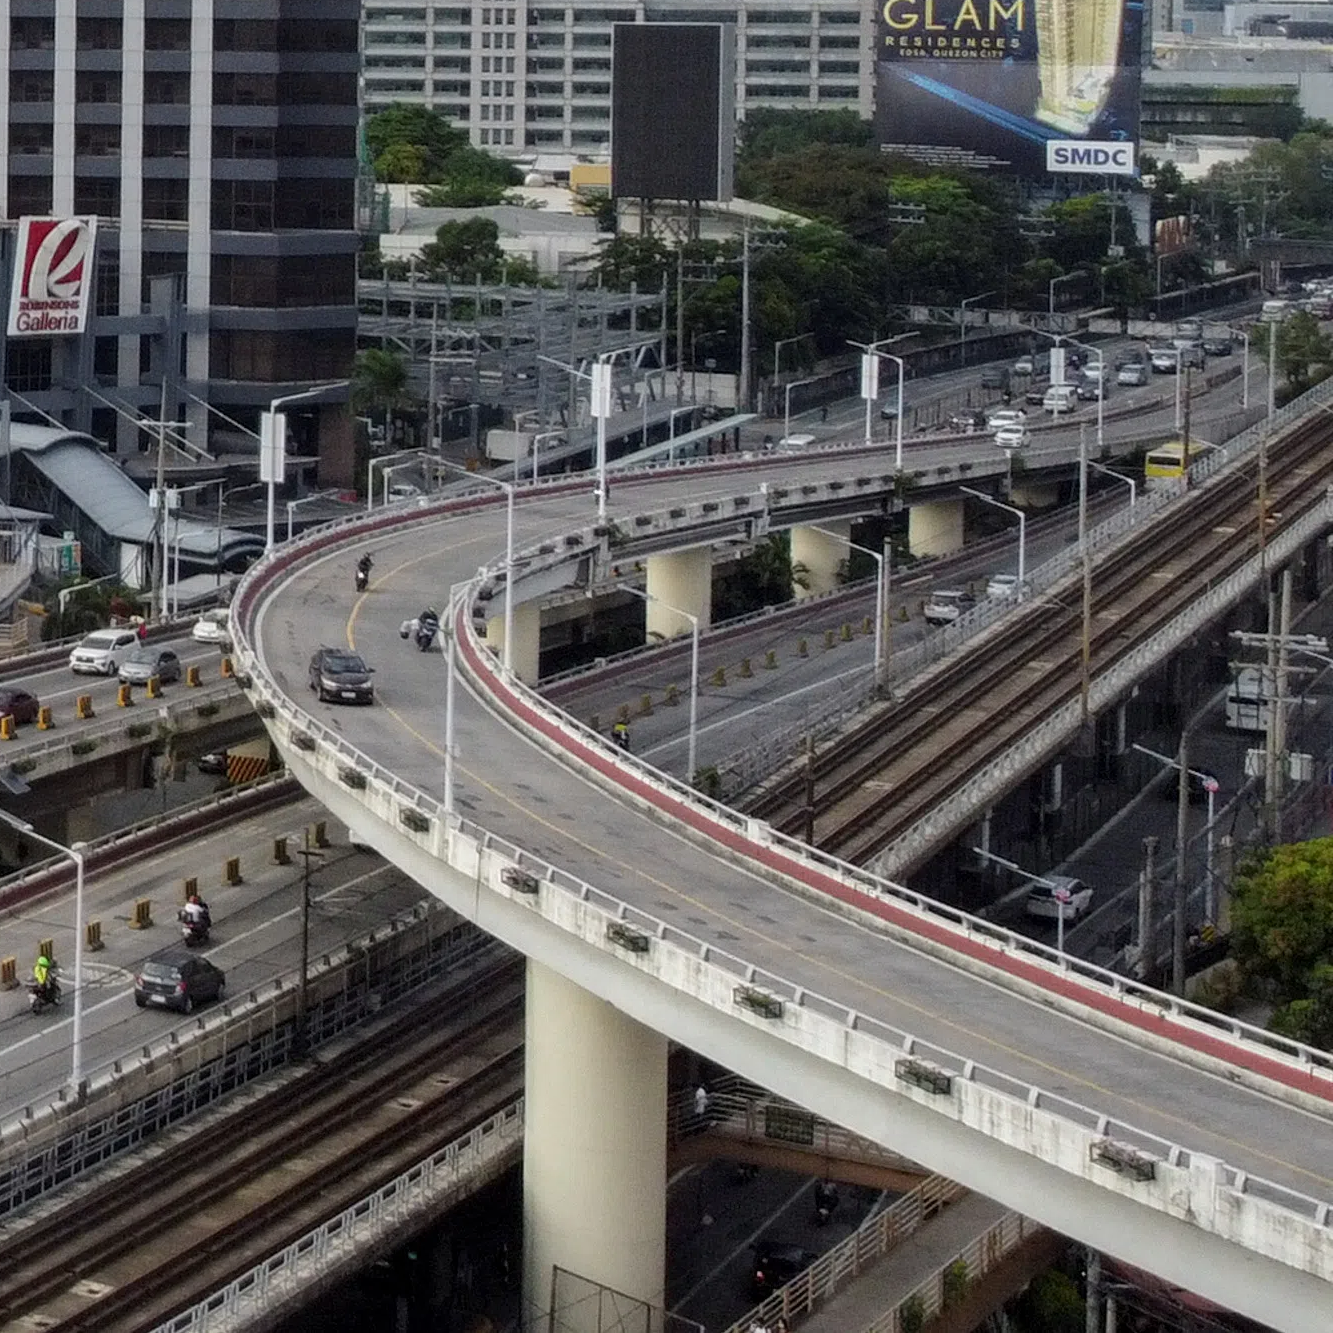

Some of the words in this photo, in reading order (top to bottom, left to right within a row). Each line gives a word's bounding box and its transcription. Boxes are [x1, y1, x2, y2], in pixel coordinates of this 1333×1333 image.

[885, 36, 1020, 49] RESIDENCES
[1054, 147, 1127, 166] SMDC
[16, 311, 79, 332] Galleria
